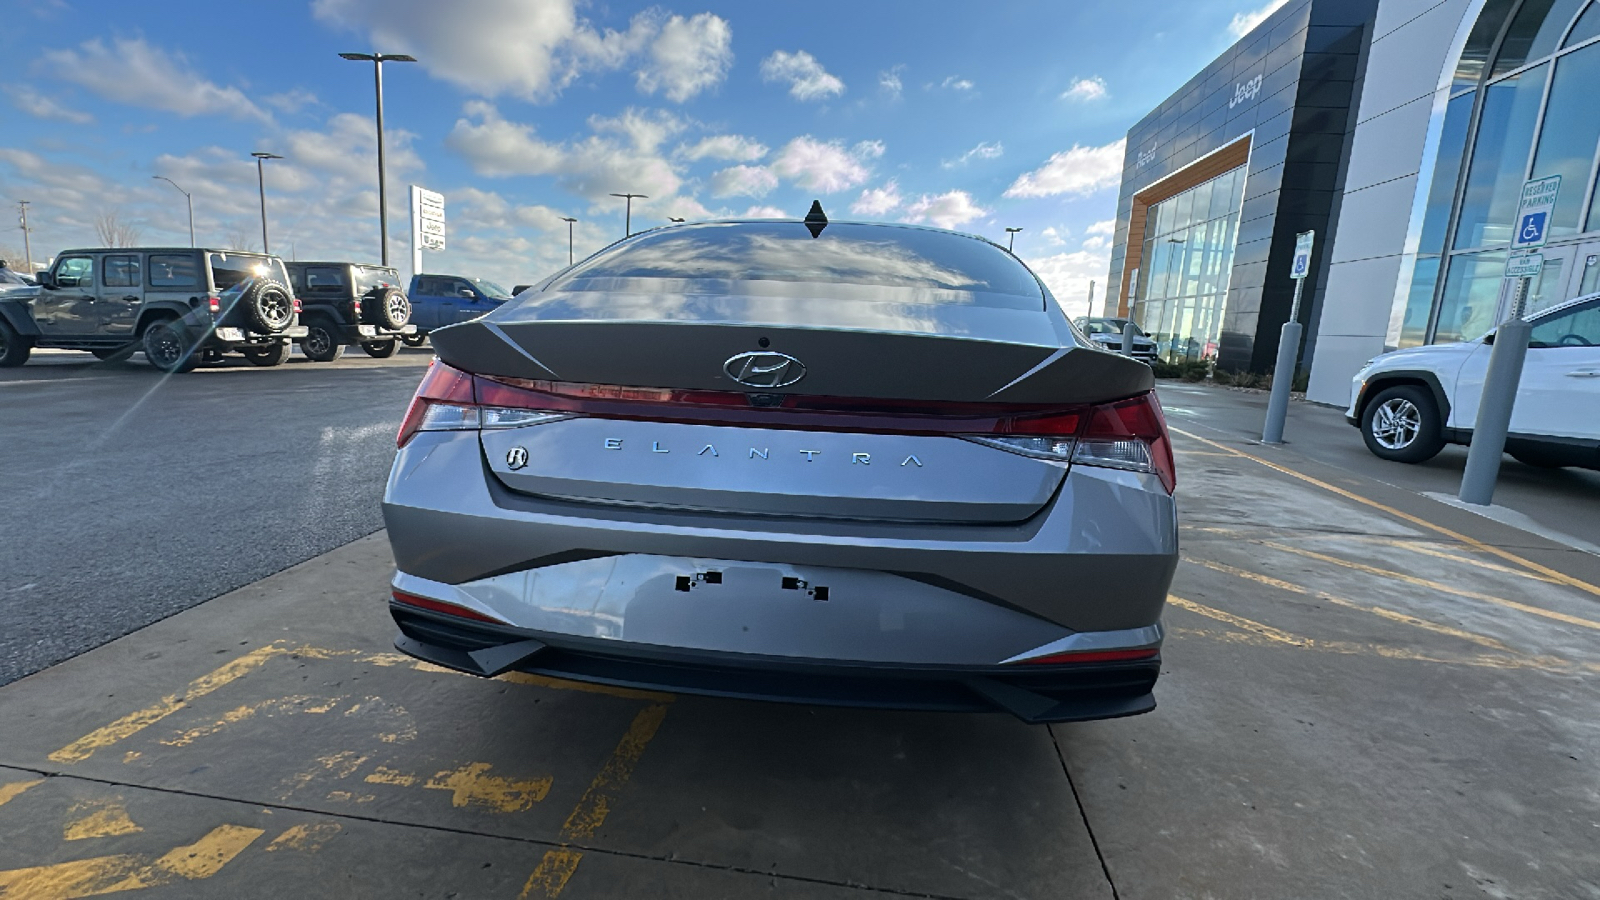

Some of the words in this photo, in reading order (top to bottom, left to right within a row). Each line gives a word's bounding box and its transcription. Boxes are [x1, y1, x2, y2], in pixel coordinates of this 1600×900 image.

[1229, 73, 1262, 109] Jeep
[1521, 193, 1555, 208] PARKING
[1524, 181, 1558, 197] RESERVED
[604, 437, 923, 467] ELANTRA
